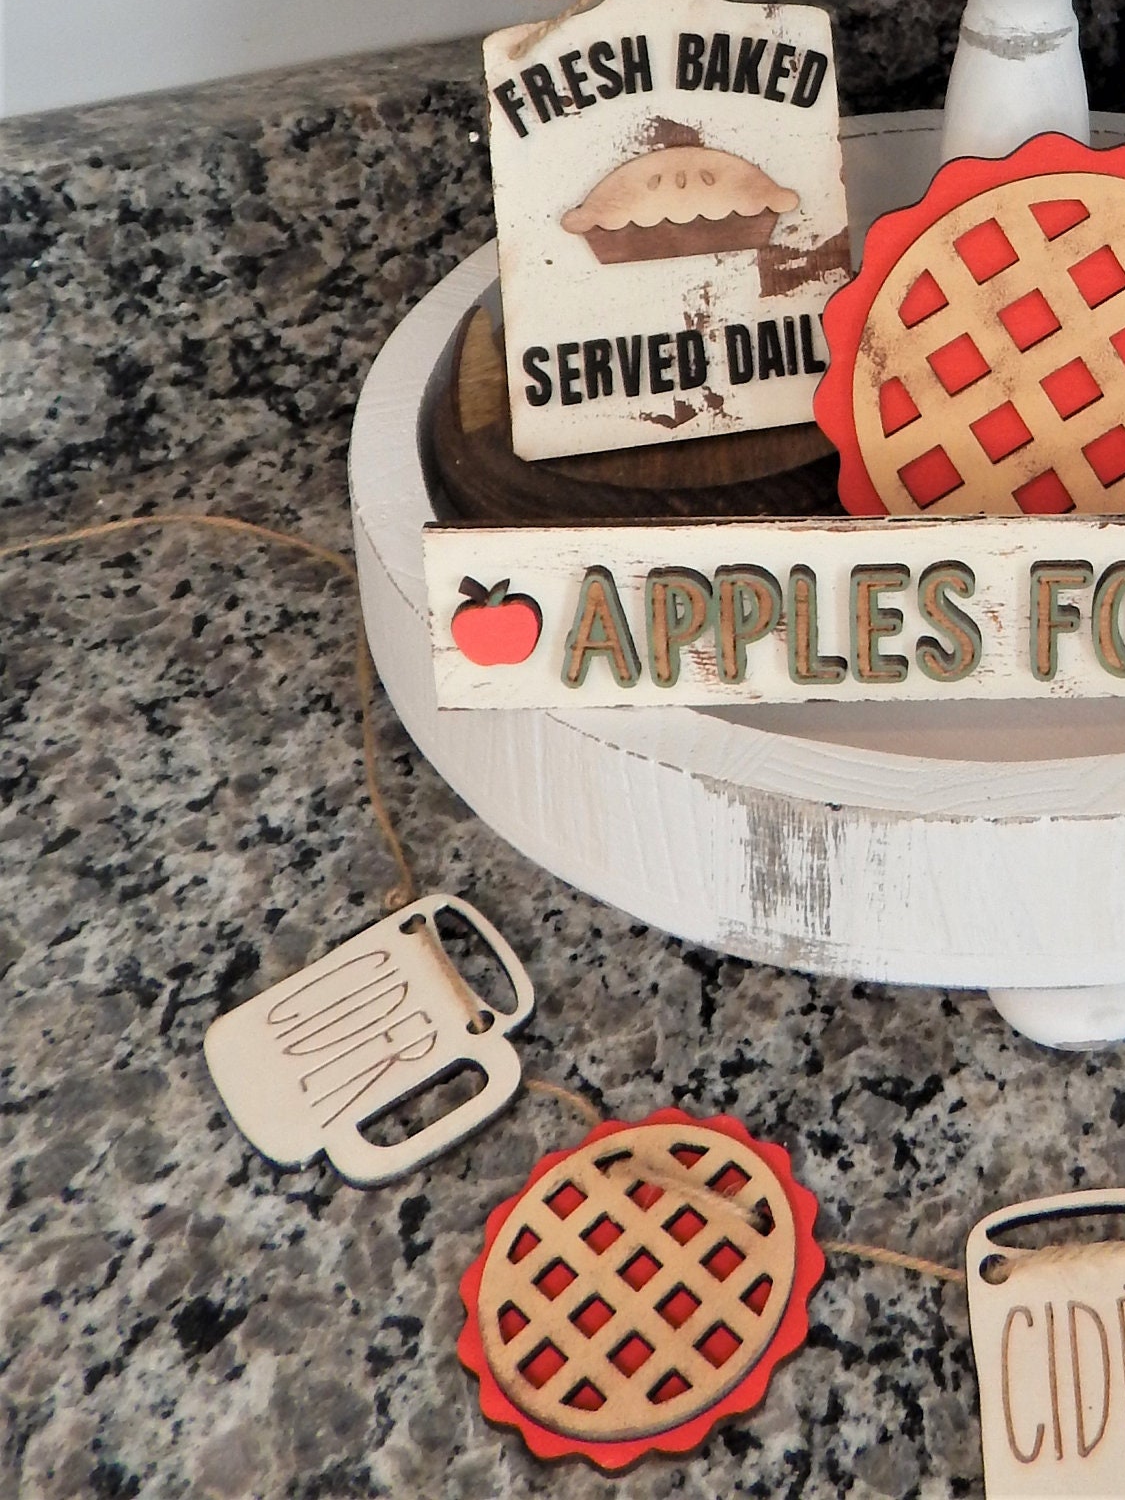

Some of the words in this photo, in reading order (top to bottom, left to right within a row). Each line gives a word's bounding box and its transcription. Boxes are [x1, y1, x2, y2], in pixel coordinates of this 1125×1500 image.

[494, 34, 653, 138] FRESH
[676, 32, 828, 109] BAKED
[522, 329, 708, 407] SERVED
[724, 312, 828, 385] DAIL
[560, 559, 982, 689] APPLES
[267, 950, 438, 1129] CIDER
